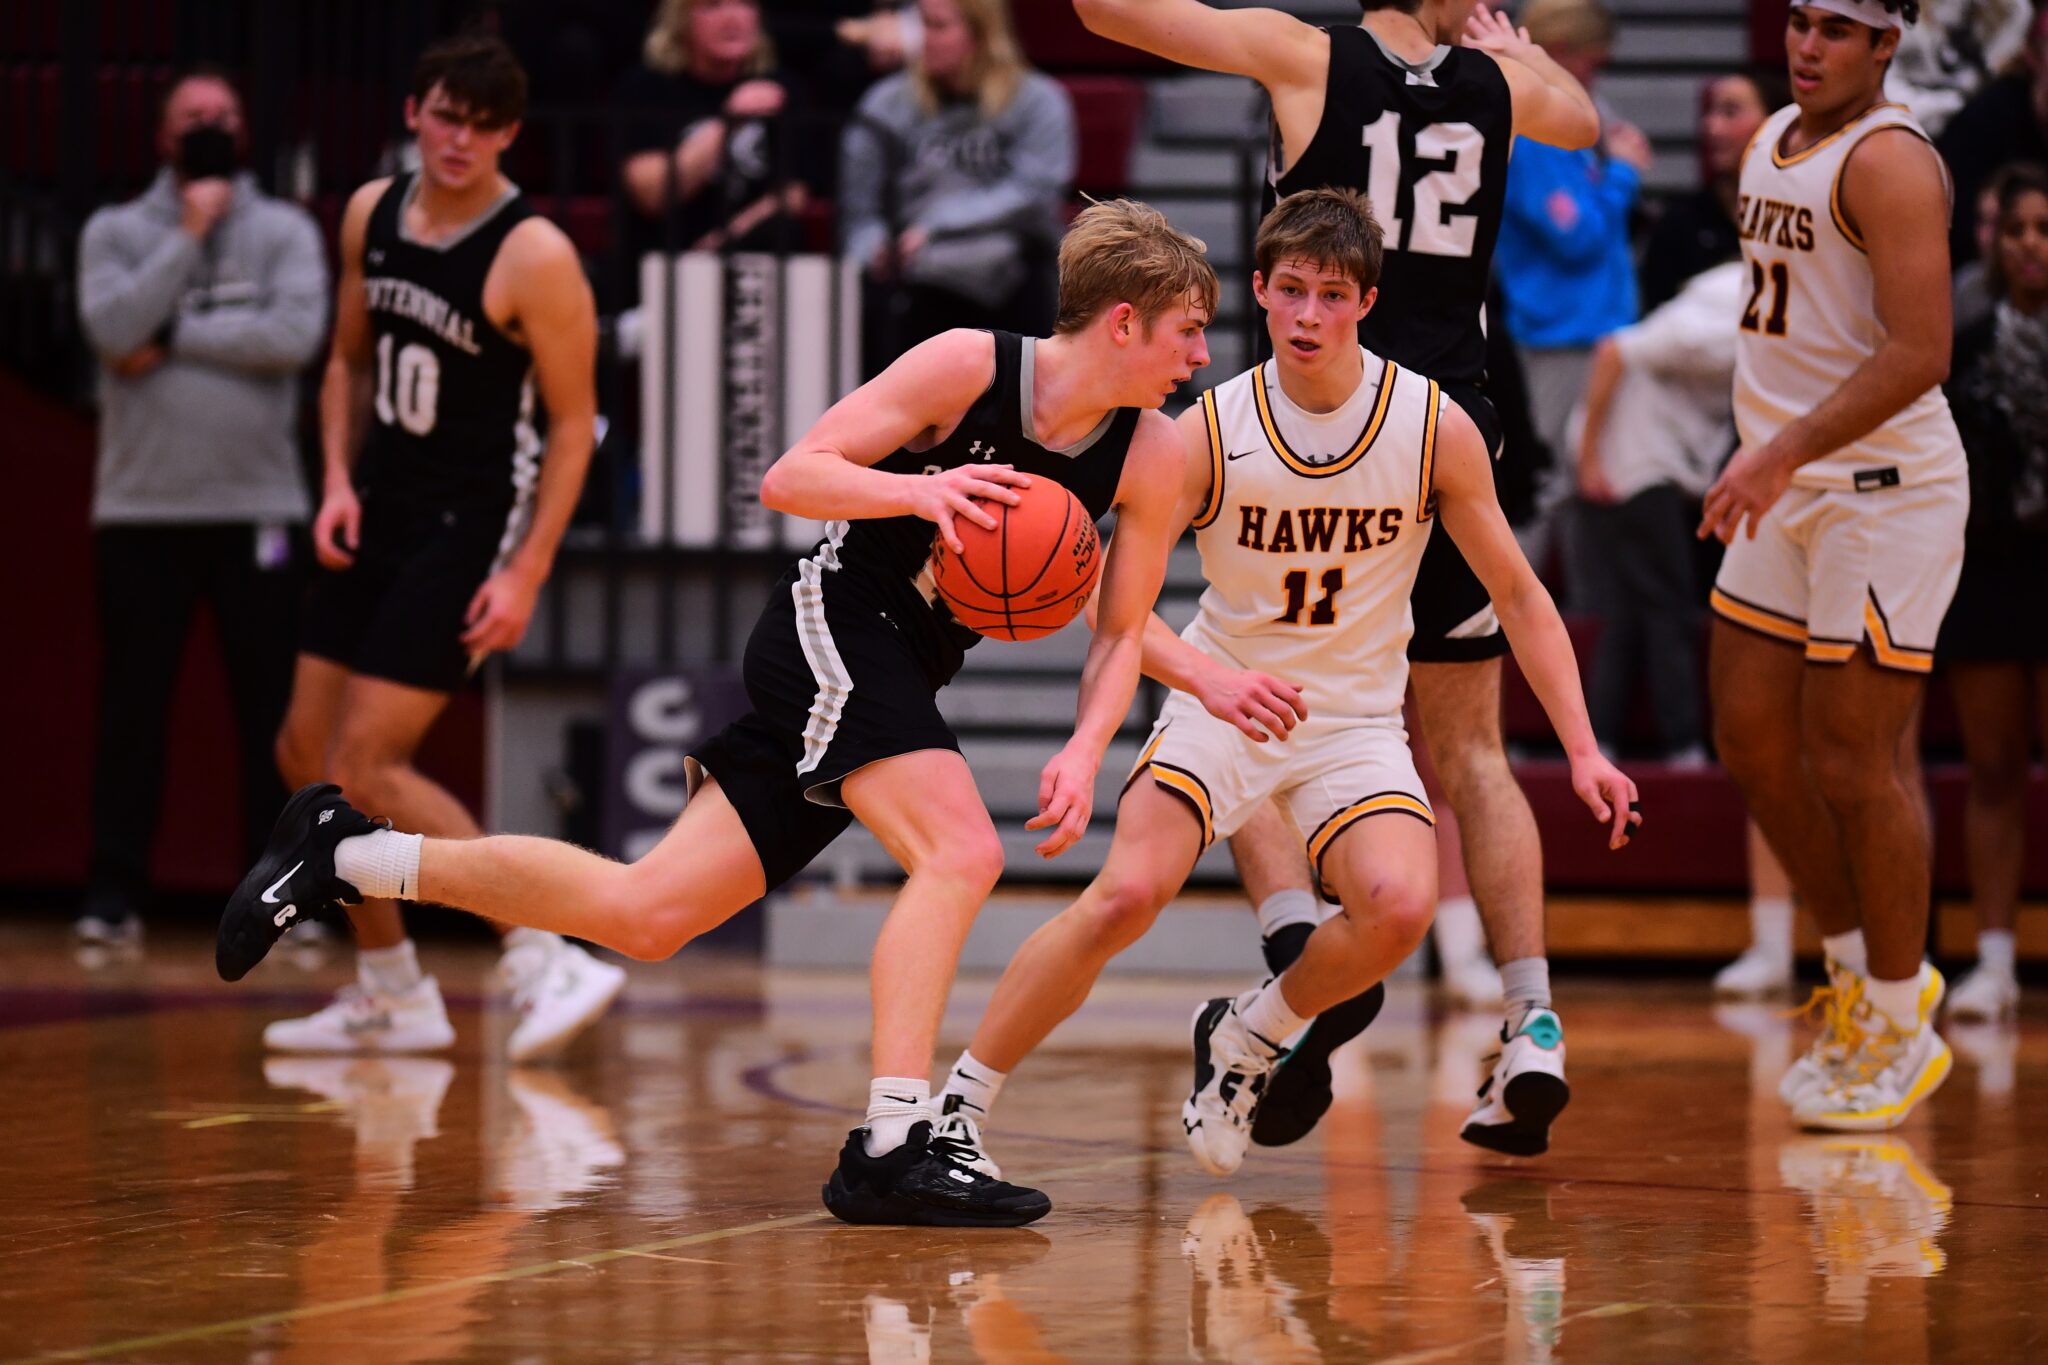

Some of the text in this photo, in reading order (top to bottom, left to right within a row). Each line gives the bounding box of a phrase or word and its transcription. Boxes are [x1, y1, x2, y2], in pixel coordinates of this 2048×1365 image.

[1361, 109, 1486, 258] 12
[1739, 257, 1789, 338] 21
[375, 332, 440, 437] 10
[1237, 505, 1404, 554] HAWKS
[1271, 565, 1345, 628] 11
